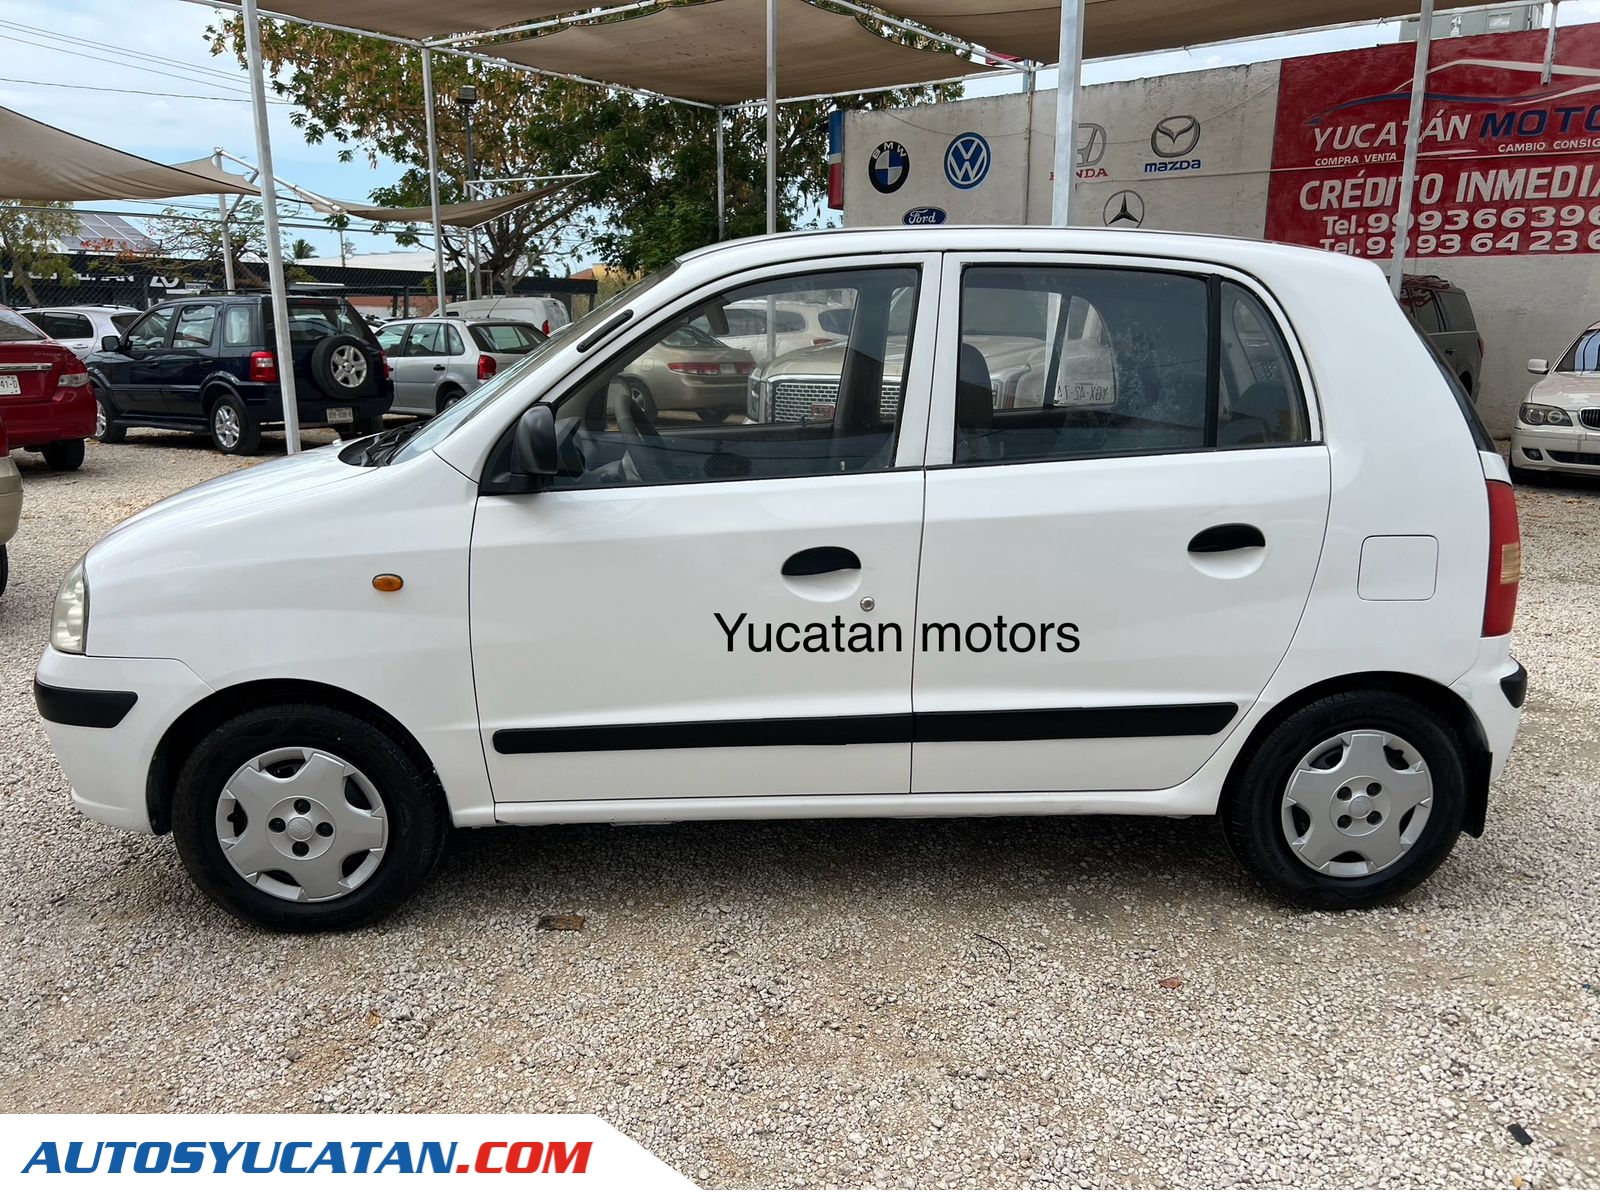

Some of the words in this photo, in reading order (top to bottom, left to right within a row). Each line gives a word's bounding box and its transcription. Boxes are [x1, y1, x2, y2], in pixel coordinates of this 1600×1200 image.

[872, 142, 907, 160] BMW
[1498, 142, 1545, 153] CAMBIO
[1553, 138, 1600, 150] CONSIG
[1315, 155, 1359, 166] COMPRA
[1364, 152, 1397, 162] VENTA
[1049, 167, 1109, 181] NDA
[908, 208, 937, 224] Ford
